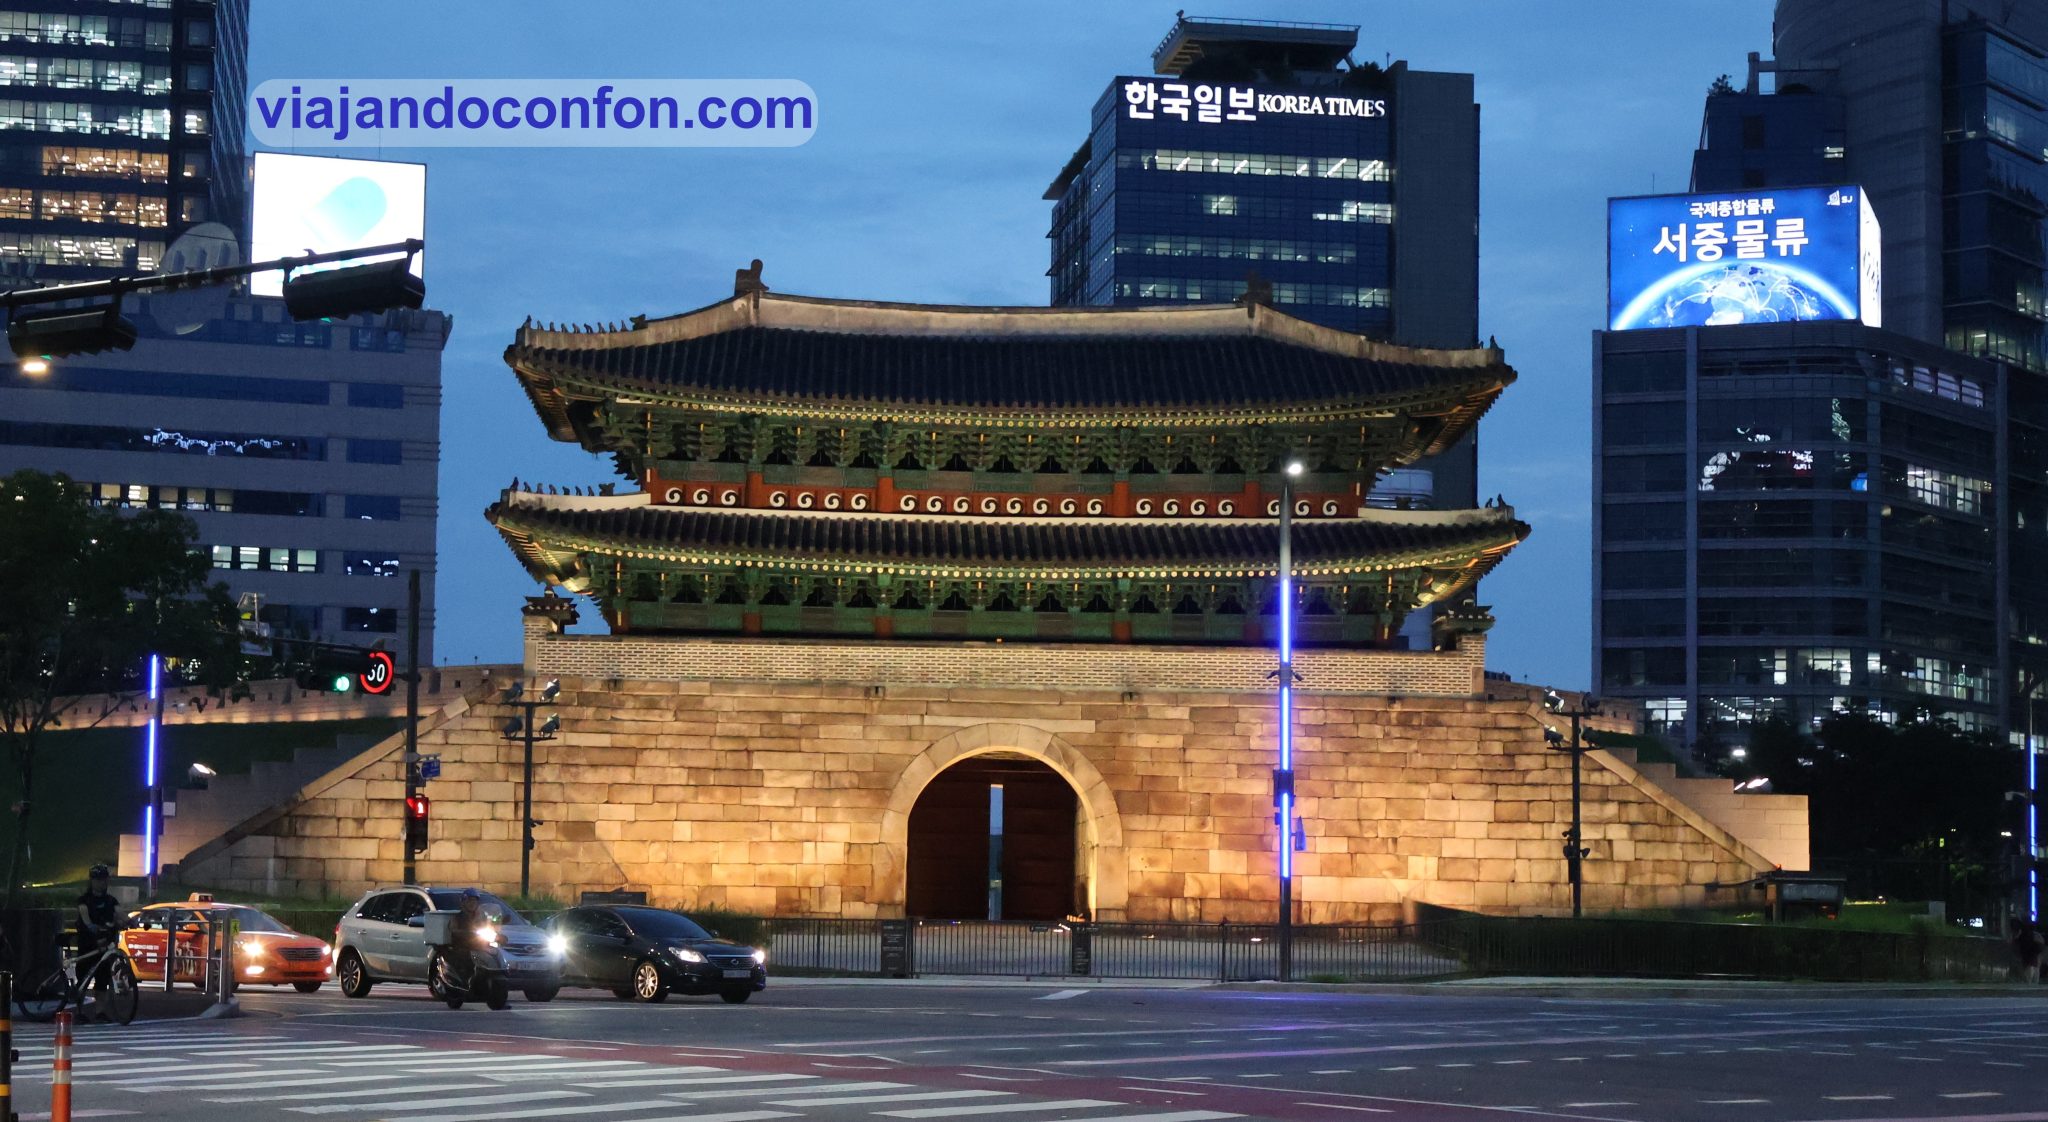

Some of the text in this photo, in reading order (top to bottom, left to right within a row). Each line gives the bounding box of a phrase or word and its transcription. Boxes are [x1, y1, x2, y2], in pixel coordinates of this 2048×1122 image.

[1125, 81, 1256, 123] 한국일보
[1258, 93, 1385, 118] KOREA TIMES
[1689, 198, 1775, 218] 국제종합물류
[1841, 195, 1853, 203] SJ
[1652, 218, 1808, 262] 서중물류
